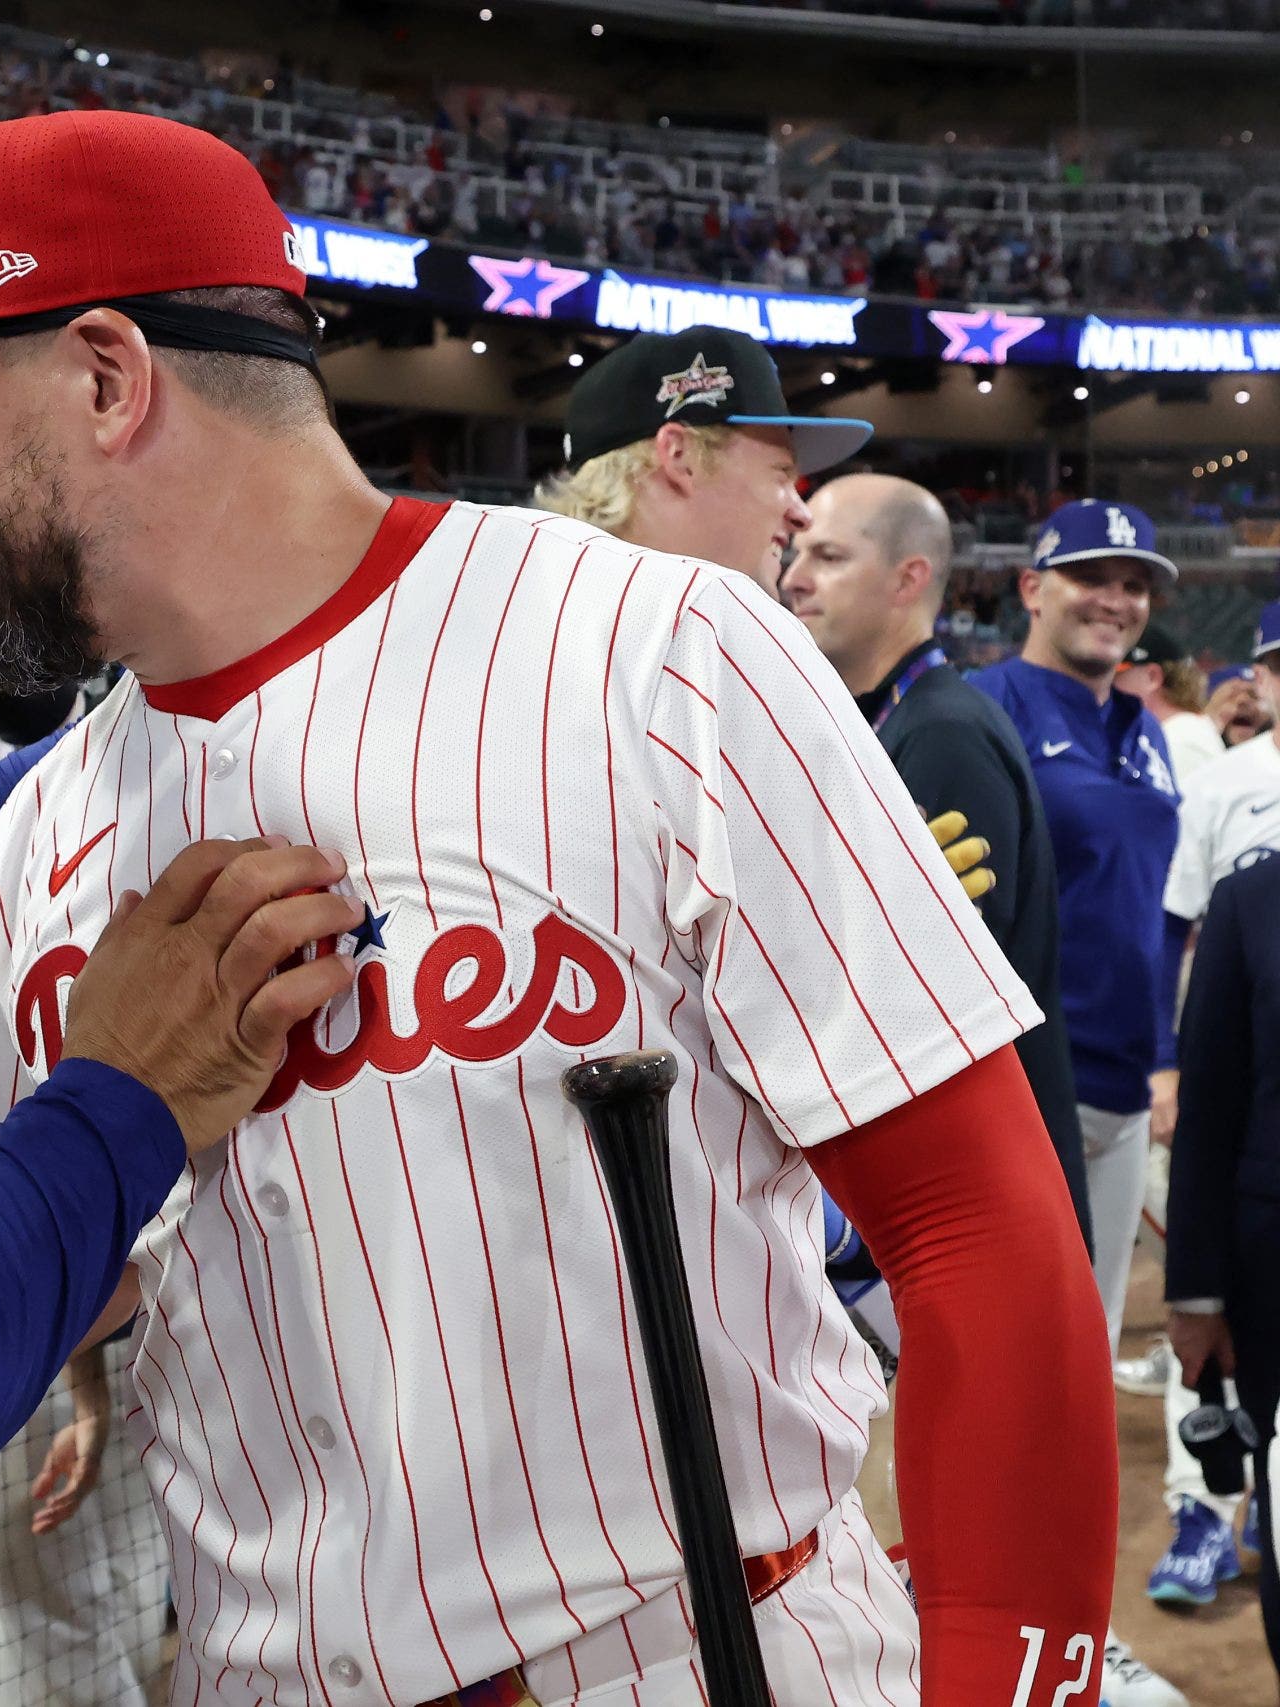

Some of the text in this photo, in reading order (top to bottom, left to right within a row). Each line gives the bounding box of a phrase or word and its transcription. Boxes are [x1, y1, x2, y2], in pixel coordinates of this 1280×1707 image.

[595, 279, 770, 341] NATIONAL
[1077, 325, 1254, 372] NATIONAL
[1105, 507, 1137, 548] LA
[1011, 1625, 1095, 1707] 12
